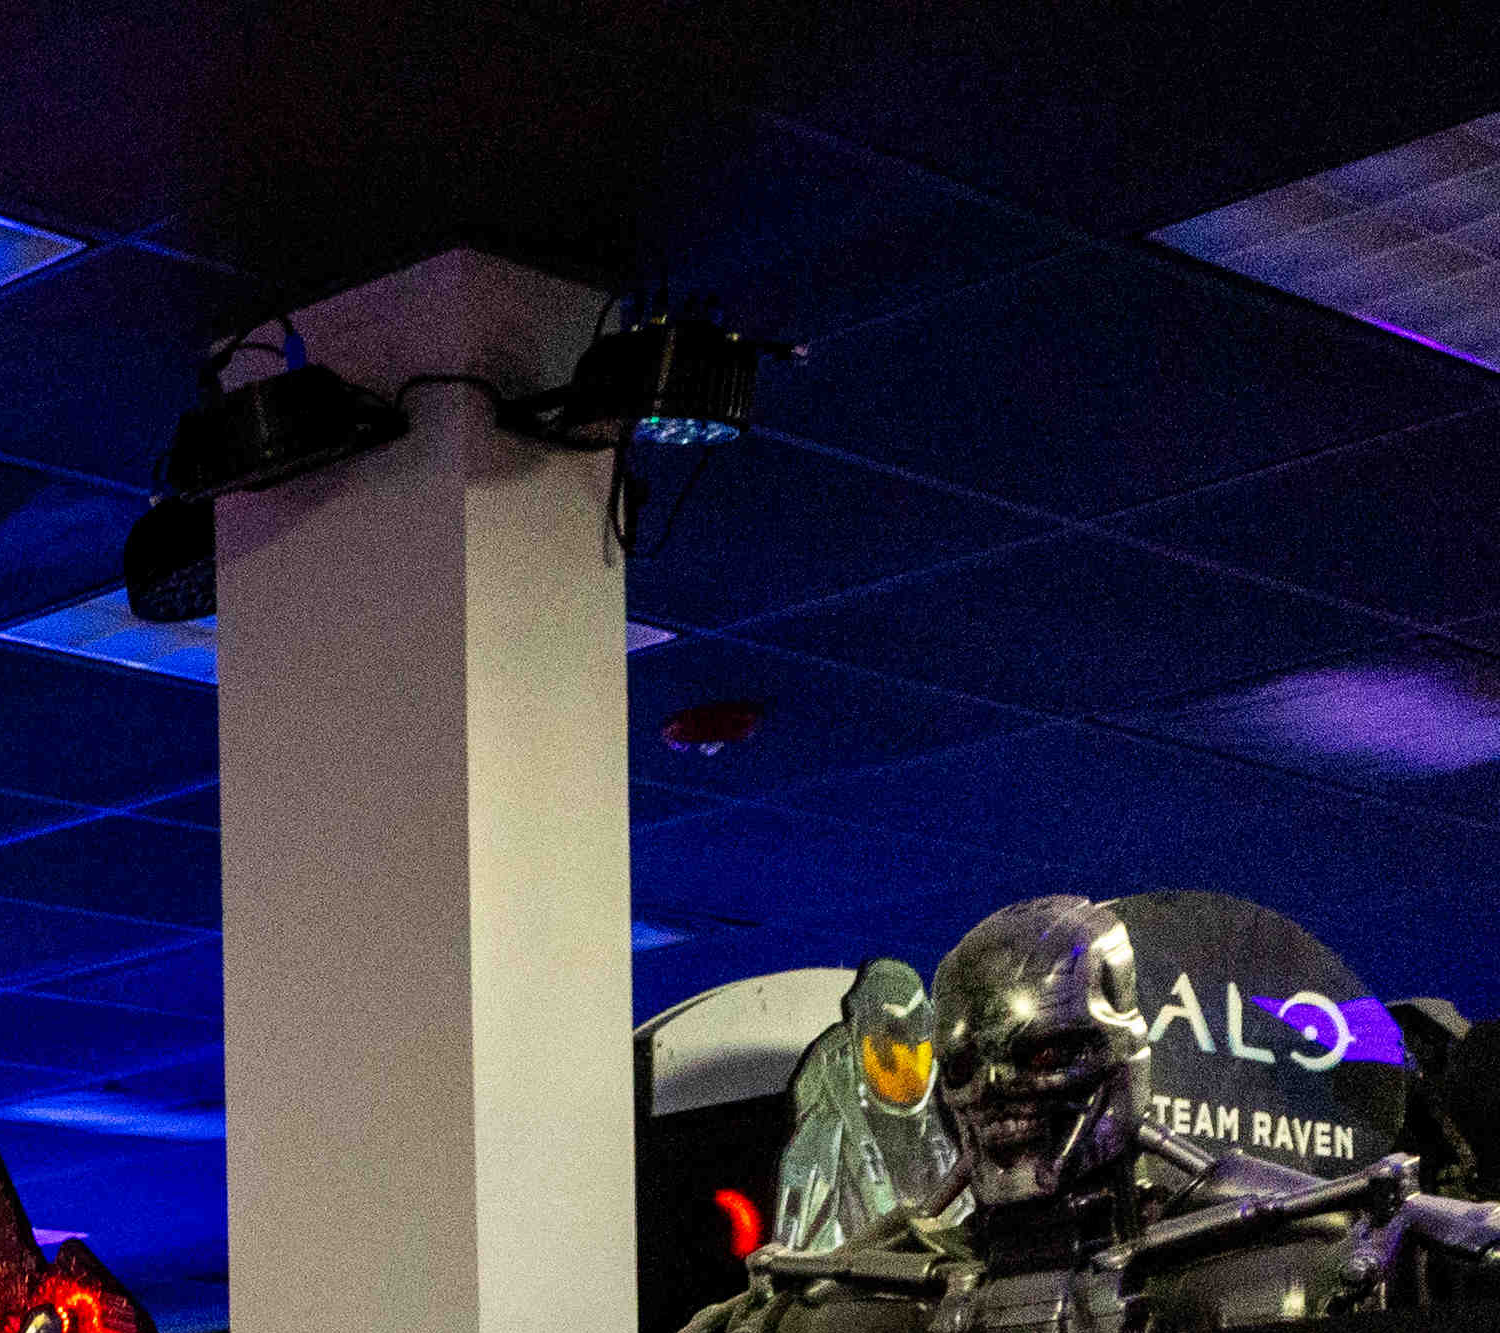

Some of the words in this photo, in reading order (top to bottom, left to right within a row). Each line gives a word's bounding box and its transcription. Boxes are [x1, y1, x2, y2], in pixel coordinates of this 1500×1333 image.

[1149, 972, 1356, 1072] ALO
[1152, 1095, 1240, 1141] TEAM
[1253, 1111, 1353, 1160] RAVEN
